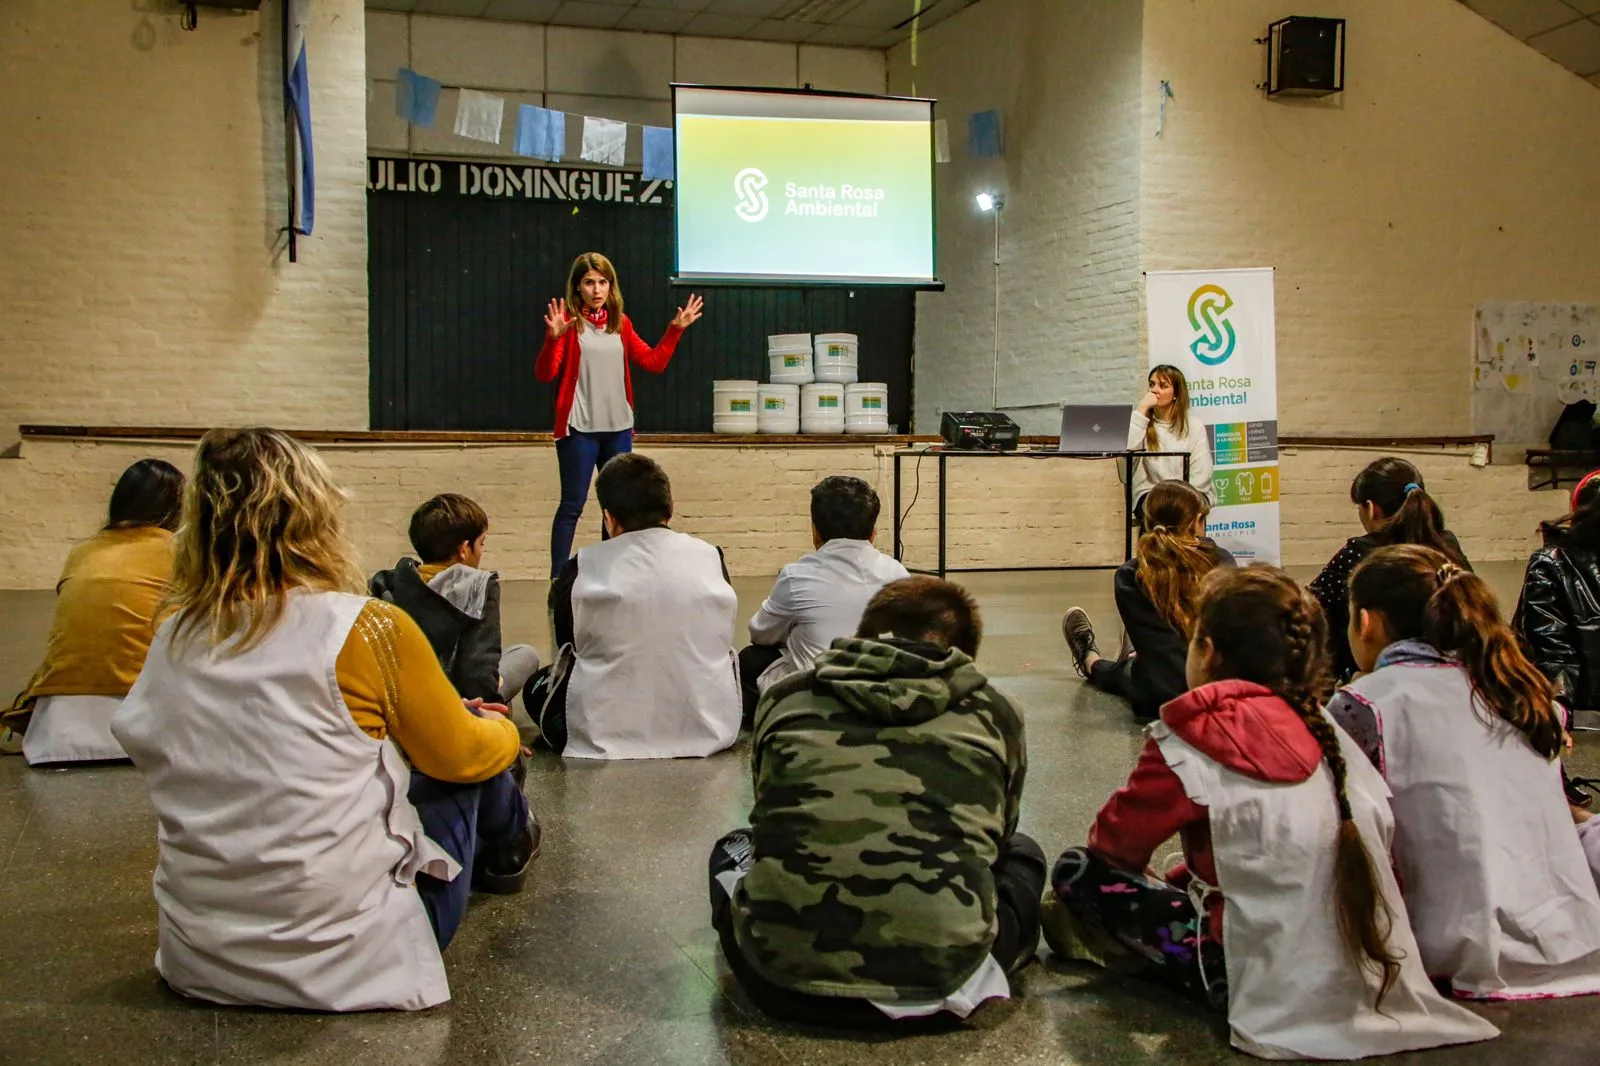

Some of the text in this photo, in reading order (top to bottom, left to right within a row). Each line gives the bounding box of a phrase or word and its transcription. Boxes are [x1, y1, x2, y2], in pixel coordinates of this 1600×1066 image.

[367, 160, 441, 193] ULIO
[785, 182, 884, 200] Santa Rosa
[785, 200, 878, 218] Ambiental
[1186, 376, 1251, 391] anta Rosa
[1189, 391, 1247, 407] mbiental
[1206, 520, 1256, 532] anta Rosa
[1207, 529, 1256, 538] UNICIPIO
